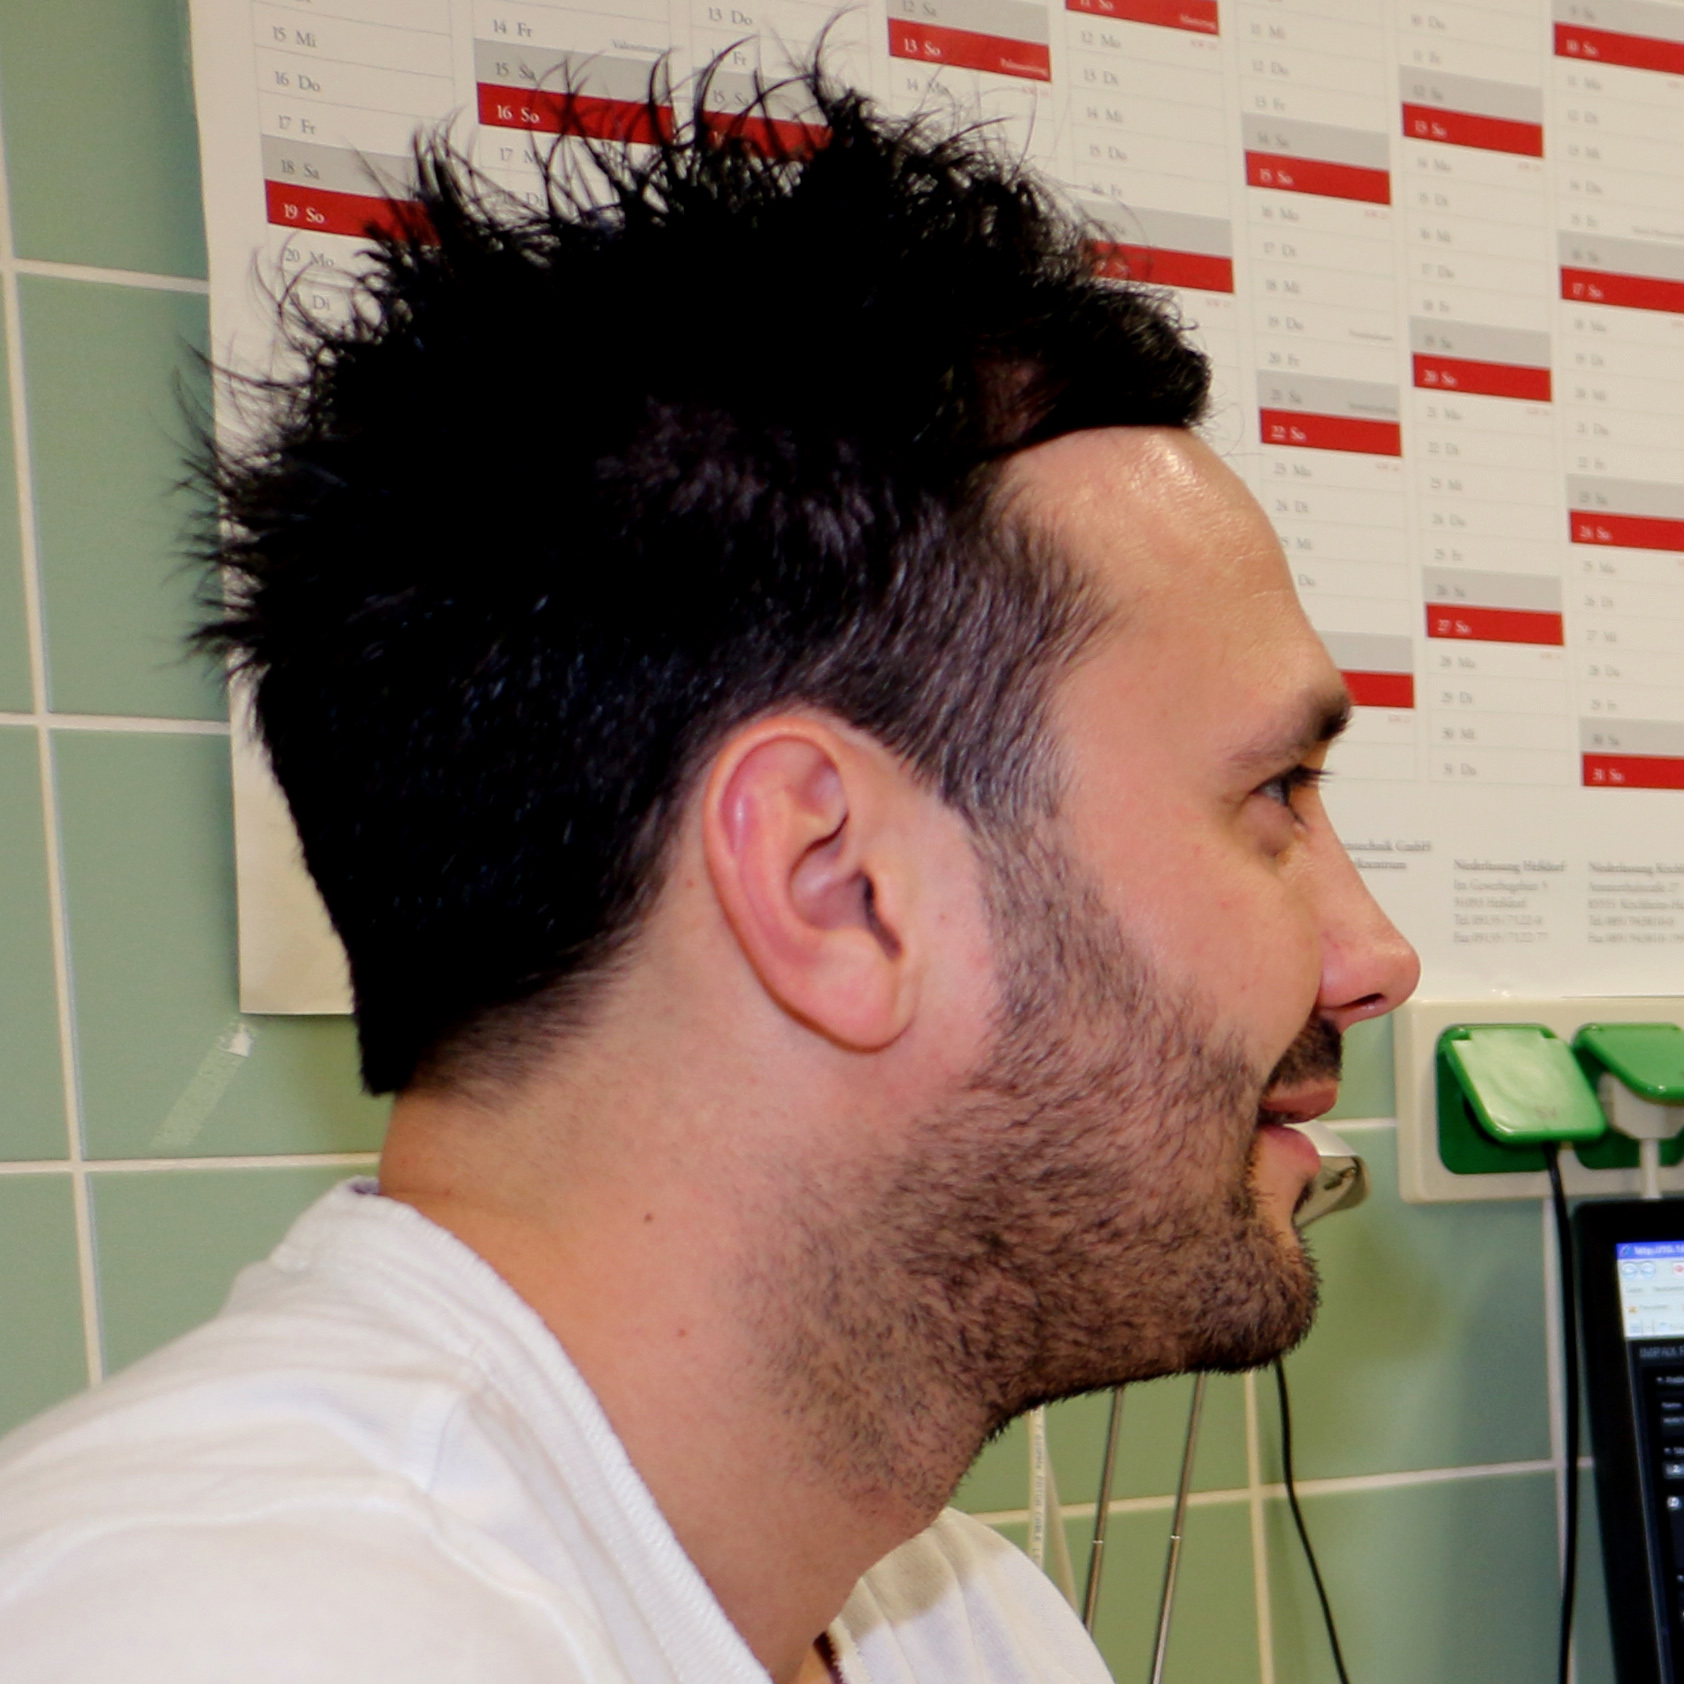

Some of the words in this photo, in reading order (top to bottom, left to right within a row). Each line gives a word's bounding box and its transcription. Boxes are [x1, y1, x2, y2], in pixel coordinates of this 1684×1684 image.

[708, 7, 722, 21] 13
[731, 9, 753, 26] Do
[272, 26, 287, 42] 15
[296, 32, 317, 48] Mi
[493, 19, 508, 35] 14
[517, 22, 533, 38] Fr
[903, 37, 918, 52] 13
[924, 40, 942, 57] So
[1080, 30, 1094, 45] 12
[1101, 32, 1121, 49] Mo
[495, 62, 510, 76] 15
[518, 65, 536, 80] Sa
[1083, 68, 1097, 83] 13
[1103, 71, 1119, 86] Di
[275, 71, 290, 86] 16
[298, 74, 321, 92] Do
[497, 105, 512, 120] 16
[521, 108, 540, 124] So
[1086, 106, 1099, 121] 14
[1106, 107, 1122, 123] Mi
[278, 115, 292, 130] 17
[301, 119, 317, 135] Fr
[1431, 122, 1447, 138] So
[281, 159, 295, 174] 18
[304, 164, 320, 180] Sa
[1260, 168, 1273, 182] 15
[1278, 170, 1294, 186] So
[284, 203, 298, 219] 19
[305, 208, 325, 224] So
[1424, 370, 1438, 384] 20
[1441, 372, 1457, 387] So
[1271, 425, 1286, 440] 22
[1290, 427, 1307, 442] So
[1437, 619, 1452, 633] 27
[1455, 620, 1472, 635] So
